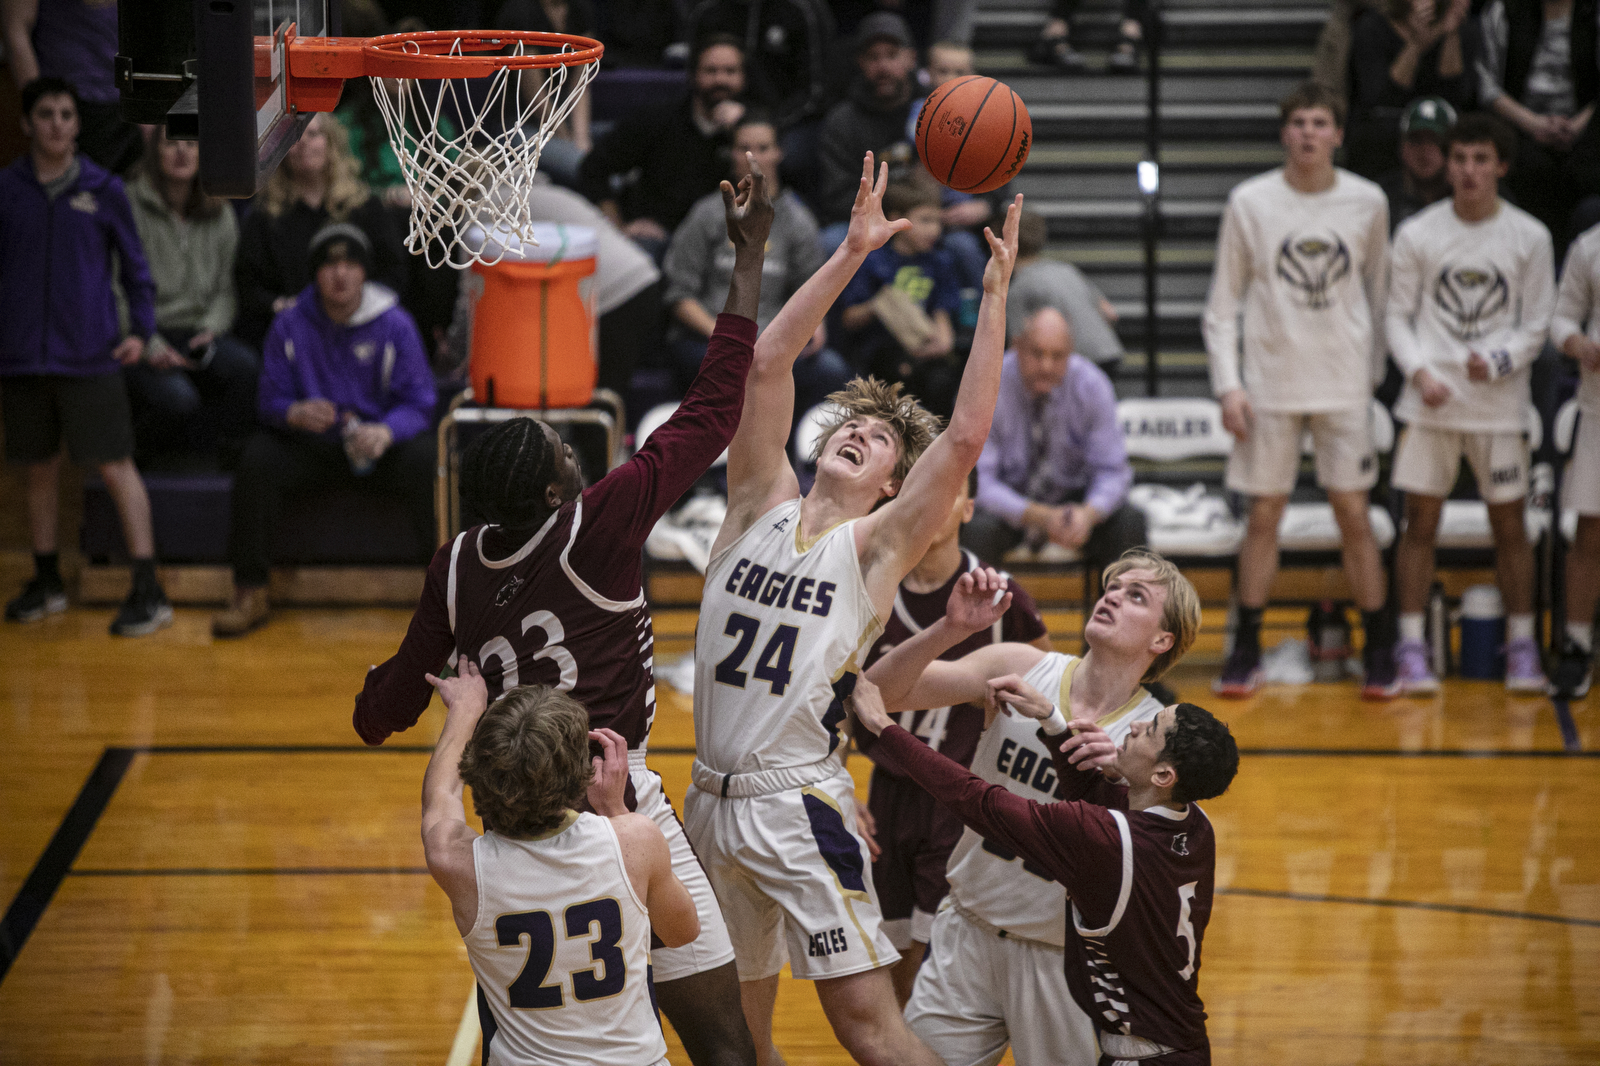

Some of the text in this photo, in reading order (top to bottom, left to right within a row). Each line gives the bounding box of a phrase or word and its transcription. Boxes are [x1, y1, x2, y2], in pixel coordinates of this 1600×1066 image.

[725, 557, 837, 618] EAGLES
[713, 611, 800, 698] 24
[997, 737, 1065, 801] EAG
[493, 895, 628, 1011] 23
[1176, 880, 1199, 981] 5
